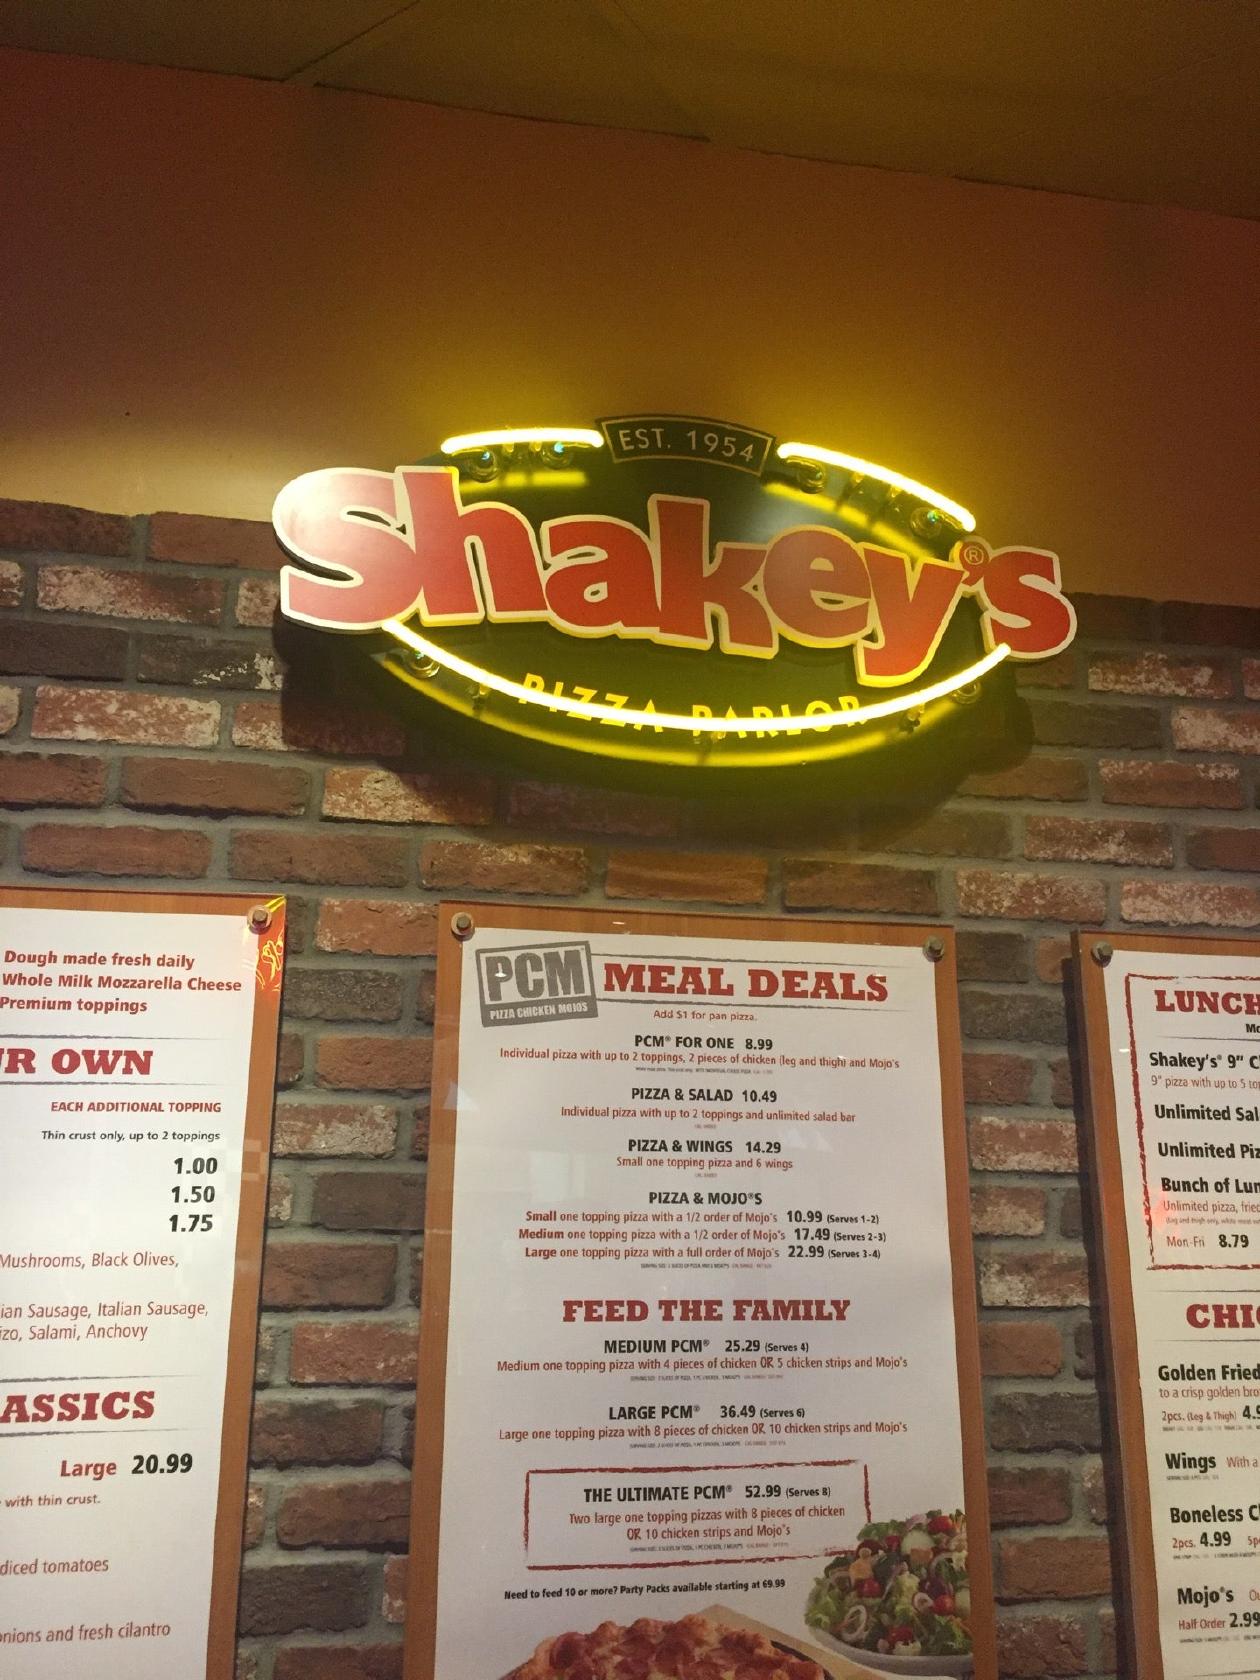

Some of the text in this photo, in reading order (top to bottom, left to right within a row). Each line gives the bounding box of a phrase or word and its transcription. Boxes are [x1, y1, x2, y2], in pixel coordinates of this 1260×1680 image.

[619, 429, 754, 462] EST. 1954
[518, 672, 869, 739] PIZZA PARLOR
[4, 951, 195, 970] Dough made fresh daily
[2, 973, 242, 991] Whole Milk Mozzarella Cheese
[485, 948, 585, 1002] PCM
[604, 963, 888, 1002] MEAL DEALS
[0, 996, 148, 1014] Premium toppings
[489, 1002, 588, 1020] PIZZA CHICKEN MOJOS
[653, 1010, 758, 1022] Add $1 for pan pizza.
[675, 1036, 702, 1048] FOR
[706, 1038, 735, 1049] ONE
[745, 1039, 773, 1050] 8.99
[51, 1049, 153, 1076] OWN
[631, 1088, 778, 1102] PIZZA & SALAD 10.49
[51, 1102, 221, 1113] EACH ADDITIONAL TOPPING
[1154, 1104, 1231, 1122] Unlimited
[41, 1130, 221, 1143] Thin crust only, up to 2 toppings
[628, 1139, 782, 1153] PIZZA & WINGS 14.29
[1157, 1142, 1236, 1159] Unlimited
[173, 1157, 218, 1175] 1.00
[1161, 1177, 1209, 1193] Bunch
[1214, 1178, 1230, 1193] of
[171, 1185, 216, 1204] 1.50
[648, 1192, 689, 1204] PIZZA
[693, 1192, 704, 1205] &
[1164, 1200, 1238, 1214] Unlimited pizza,
[168, 1214, 213, 1233] 1.75
[526, 1211, 557, 1221] Small
[560, 1213, 578, 1221] one
[582, 1212, 620, 1224] topping
[623, 1212, 648, 1223] pizza
[651, 1211, 674, 1222] with
[676, 1213, 682, 1222] a
[687, 1212, 700, 1222] 1/2
[703, 1212, 729, 1222] order
[733, 1212, 742, 1222] of
[787, 1210, 823, 1223] 10.99
[827, 1214, 858, 1224] (Serves
[861, 1215, 879, 1224] 1-2)
[1219, 1234, 1249, 1248] 8.79
[0, 1251, 180, 1269] Mushrooms, Black Olives,
[27, 1302, 92, 1320] Sausage,
[97, 1301, 143, 1316] Italian
[146, 1301, 210, 1318] Sausage,
[562, 1299, 850, 1323] FEED THE FAMILY
[1186, 1303, 1260, 1329] CHI
[28, 1325, 82, 1341] Salami,
[85, 1323, 148, 1341] Anchovy
[604, 1339, 667, 1353] MEDIUM
[725, 1339, 761, 1352] 25.29
[764, 1342, 798, 1352] (Serves
[800, 1342, 809, 1352] 4)
[1158, 1364, 1216, 1381] Golden
[0, 1390, 155, 1424] ASSICS
[609, 1406, 656, 1420] LARGE
[720, 1405, 756, 1418] 36.49
[760, 1408, 794, 1419] (Serves
[796, 1408, 805, 1418] 6)
[1161, 1411, 1185, 1422] 2pcs.
[1187, 1411, 1203, 1422] (Leg
[60, 1453, 194, 1480] Large 20.99
[1165, 1452, 1217, 1472] Wings
[5, 1494, 101, 1507] with thin crust.
[584, 1488, 612, 1503] THE
[617, 1486, 689, 1501] ULTIMATE
[745, 1484, 782, 1498] 52.99
[785, 1488, 819, 1499] (Serves
[821, 1487, 831, 1497] 8)
[1170, 1505, 1243, 1523] Boneless
[1172, 1531, 1231, 1550] 2pcs. 4.99
[0, 1557, 110, 1575] diced tomatoes
[504, 1579, 786, 1600] Need to feed 10 or more? Party Packs available starting at 69.99
[46, 1625, 74, 1641] and
[77, 1624, 114, 1641] fresh
[117, 1622, 171, 1639] cilantro
[1179, 1619, 1197, 1630] Half
[1200, 1619, 1225, 1629] Order
